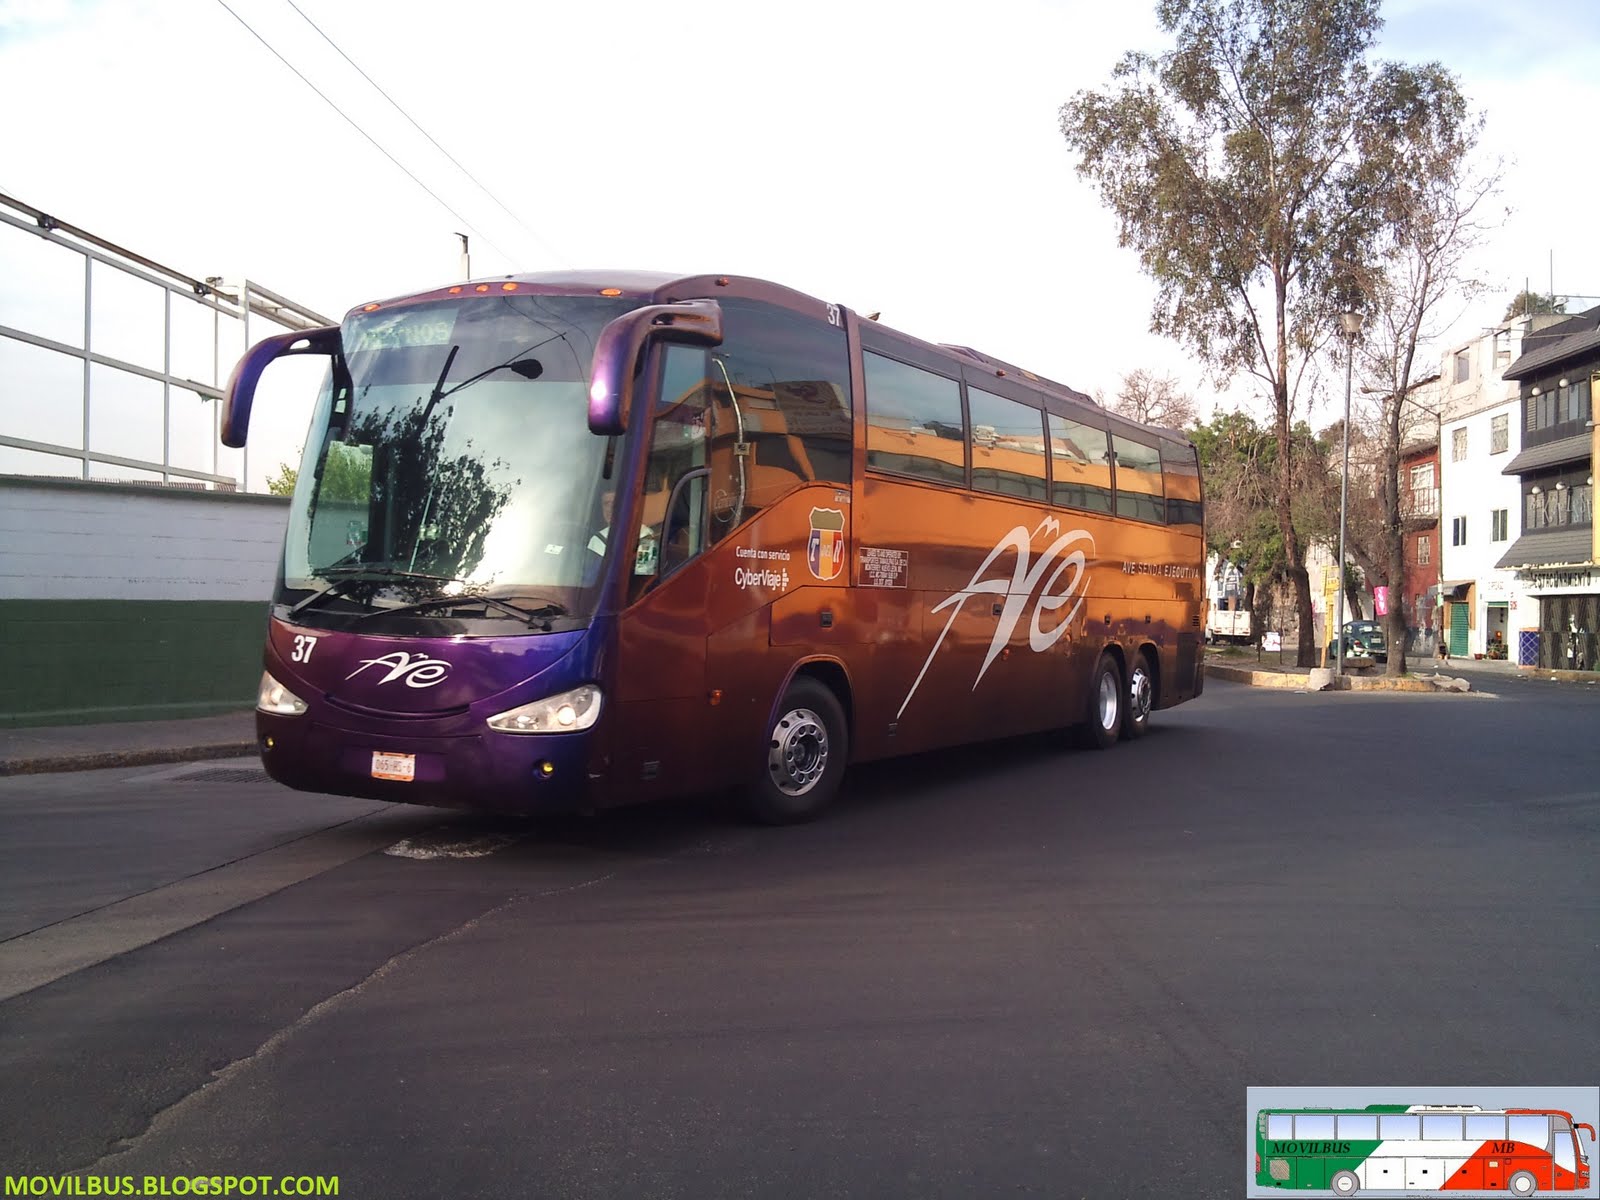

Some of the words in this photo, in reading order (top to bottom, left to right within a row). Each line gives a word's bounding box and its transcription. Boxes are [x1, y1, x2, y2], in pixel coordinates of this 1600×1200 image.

[826, 303, 840, 326] 37
[735, 546, 757, 559] Cuenta
[757, 550, 768, 559] con
[768, 550, 790, 561] servicio
[735, 567, 781, 591] CyberViaje
[1122, 561, 1136, 575] AVE
[1138, 562, 1162, 576] SENDA
[1164, 565, 1199, 579] EJECUTIVA
[291, 635, 317, 664] 37
